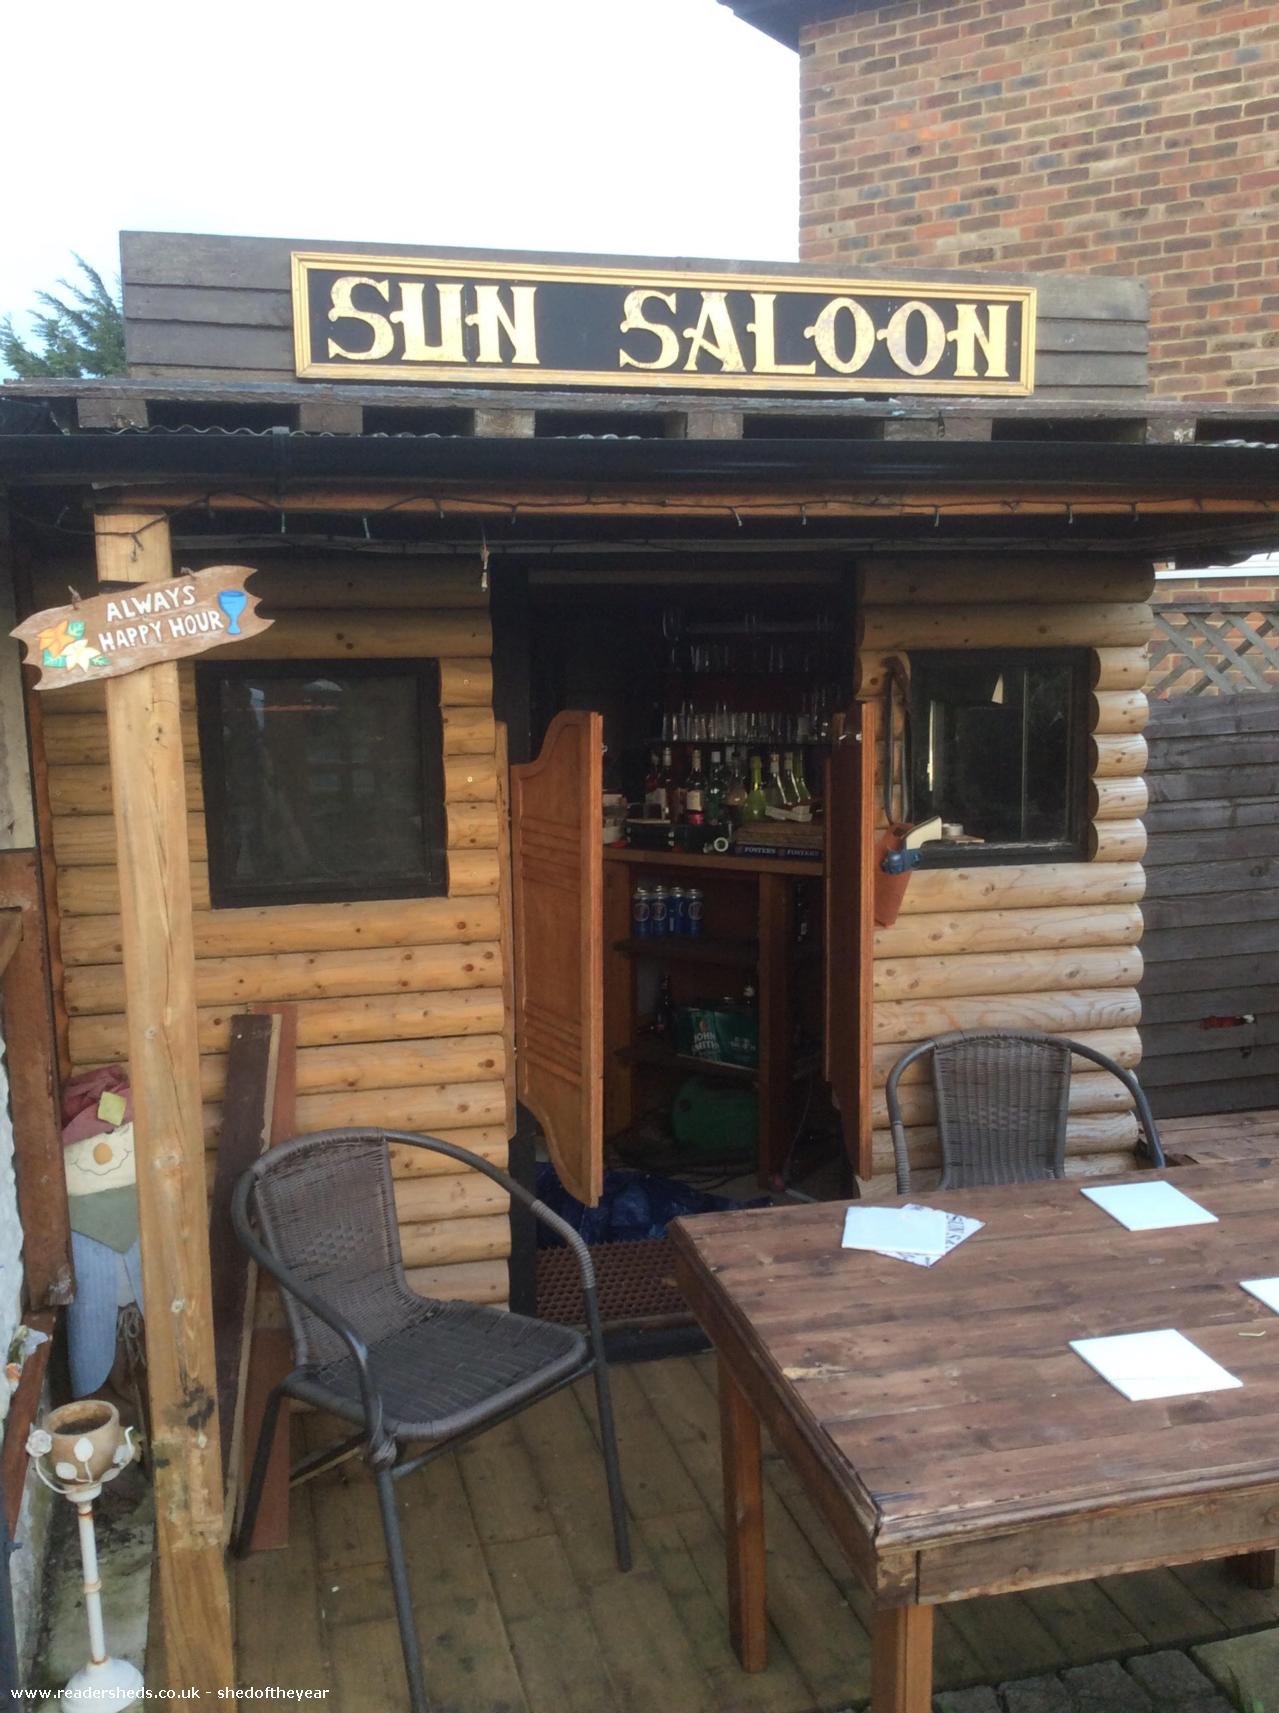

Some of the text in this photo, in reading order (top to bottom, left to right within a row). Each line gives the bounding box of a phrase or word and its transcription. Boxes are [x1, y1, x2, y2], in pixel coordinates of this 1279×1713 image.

[328, 277, 1011, 378] SUN SALOON
[106, 585, 196, 622] ALWAYS
[98, 610, 224, 652] HAPPY HOUR
